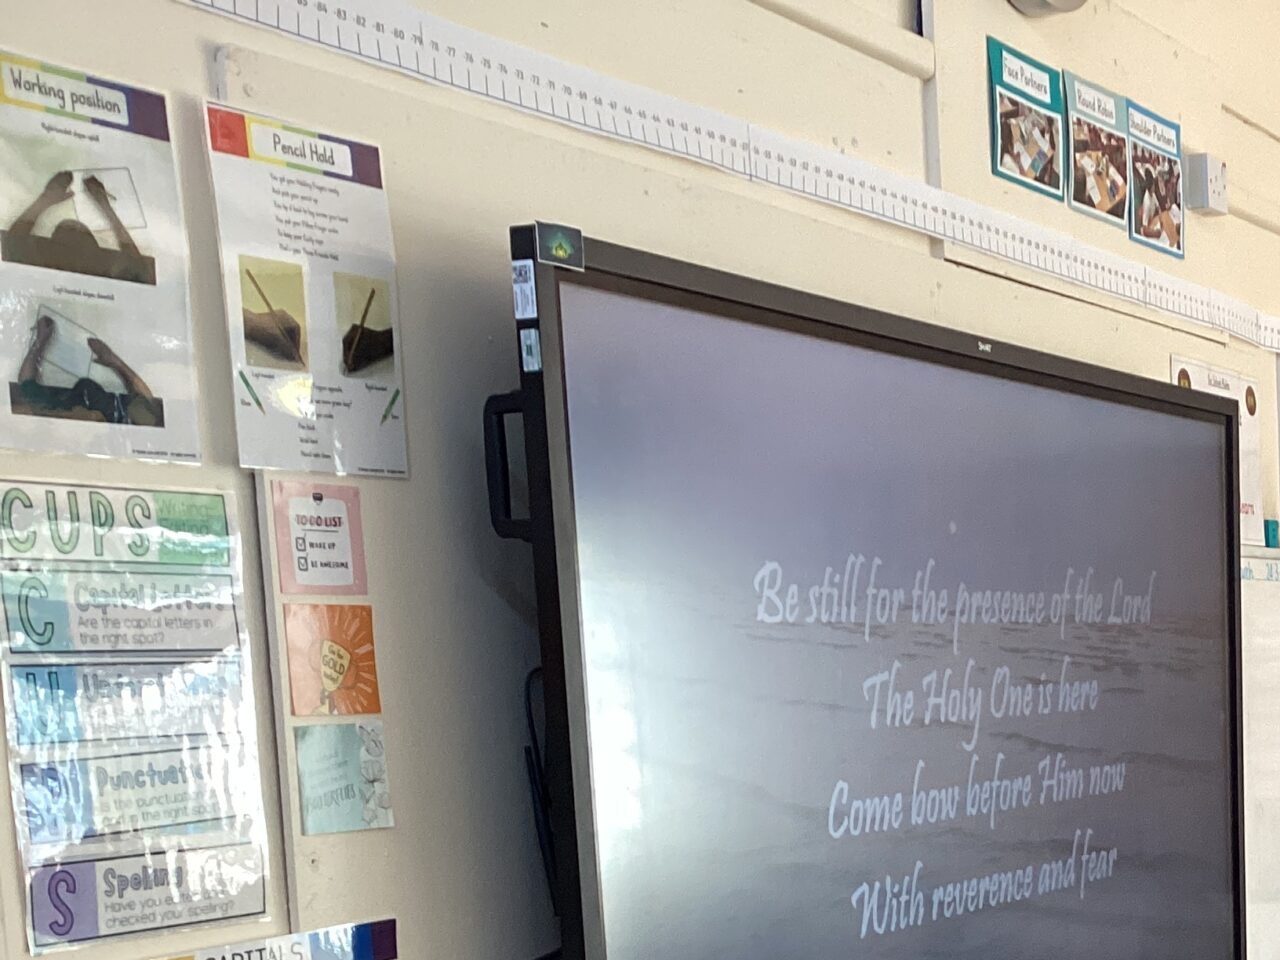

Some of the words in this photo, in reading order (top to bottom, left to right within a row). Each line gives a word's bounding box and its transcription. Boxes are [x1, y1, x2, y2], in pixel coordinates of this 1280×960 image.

[314, 3, 327, 14] -84
[333, 8, 347, 21] -83
[353, 14, 366, 28] -82
[372, 20, 385, 34] -81
[391, 27, 405, 41] -80
[10, 67, 66, 109] Working
[70, 89, 121, 112] position
[1003, 57, 1019, 80] Face
[1020, 65, 1048, 95] Partners
[1077, 88, 1096, 111] Round
[272, 132, 306, 159] Pencil
[309, 142, 335, 165] Hold
[1152, 122, 1175, 148] Partners
[1, 487, 151, 557] CUPS
[295, 514, 307, 526] TO
[324, 516, 343, 527] LIST
[18, 577, 54, 646] C
[753, 560, 798, 624] Be
[806, 553, 865, 624] still
[863, 556, 905, 642] for
[911, 558, 948, 623] the
[952, 582, 1045, 655] presence
[1050, 567, 1075, 640] of
[1075, 567, 1103, 622] the
[1108, 570, 1156, 625] Lord
[78, 615, 98, 629] Are
[101, 616, 121, 630] the
[124, 616, 162, 633] capital
[164, 616, 200, 629] letters
[203, 617, 213, 629] in
[79, 632, 99, 645] the
[102, 632, 129, 648] right
[132, 631, 165, 647] spot?
[322, 655, 346, 676] GOLD
[863, 660, 914, 729] The
[922, 658, 982, 751] Holy
[990, 666, 1033, 718] One
[1038, 673, 1050, 713] is
[1058, 656, 1099, 712] here
[828, 780, 903, 839] Come
[911, 760, 959, 825] bow
[967, 753, 1032, 829] before
[1038, 753, 1083, 805] Him
[1090, 761, 1126, 794] now
[851, 860, 925, 939] With
[932, 867, 1033, 922] reverence
[1038, 829, 1081, 892] and
[1080, 828, 1118, 899] fear
[48, 870, 77, 936] S
[105, 900, 137, 913] Have
[141, 898, 162, 912] you
[105, 911, 156, 930] checked
[187, 900, 235, 918] spelling?
